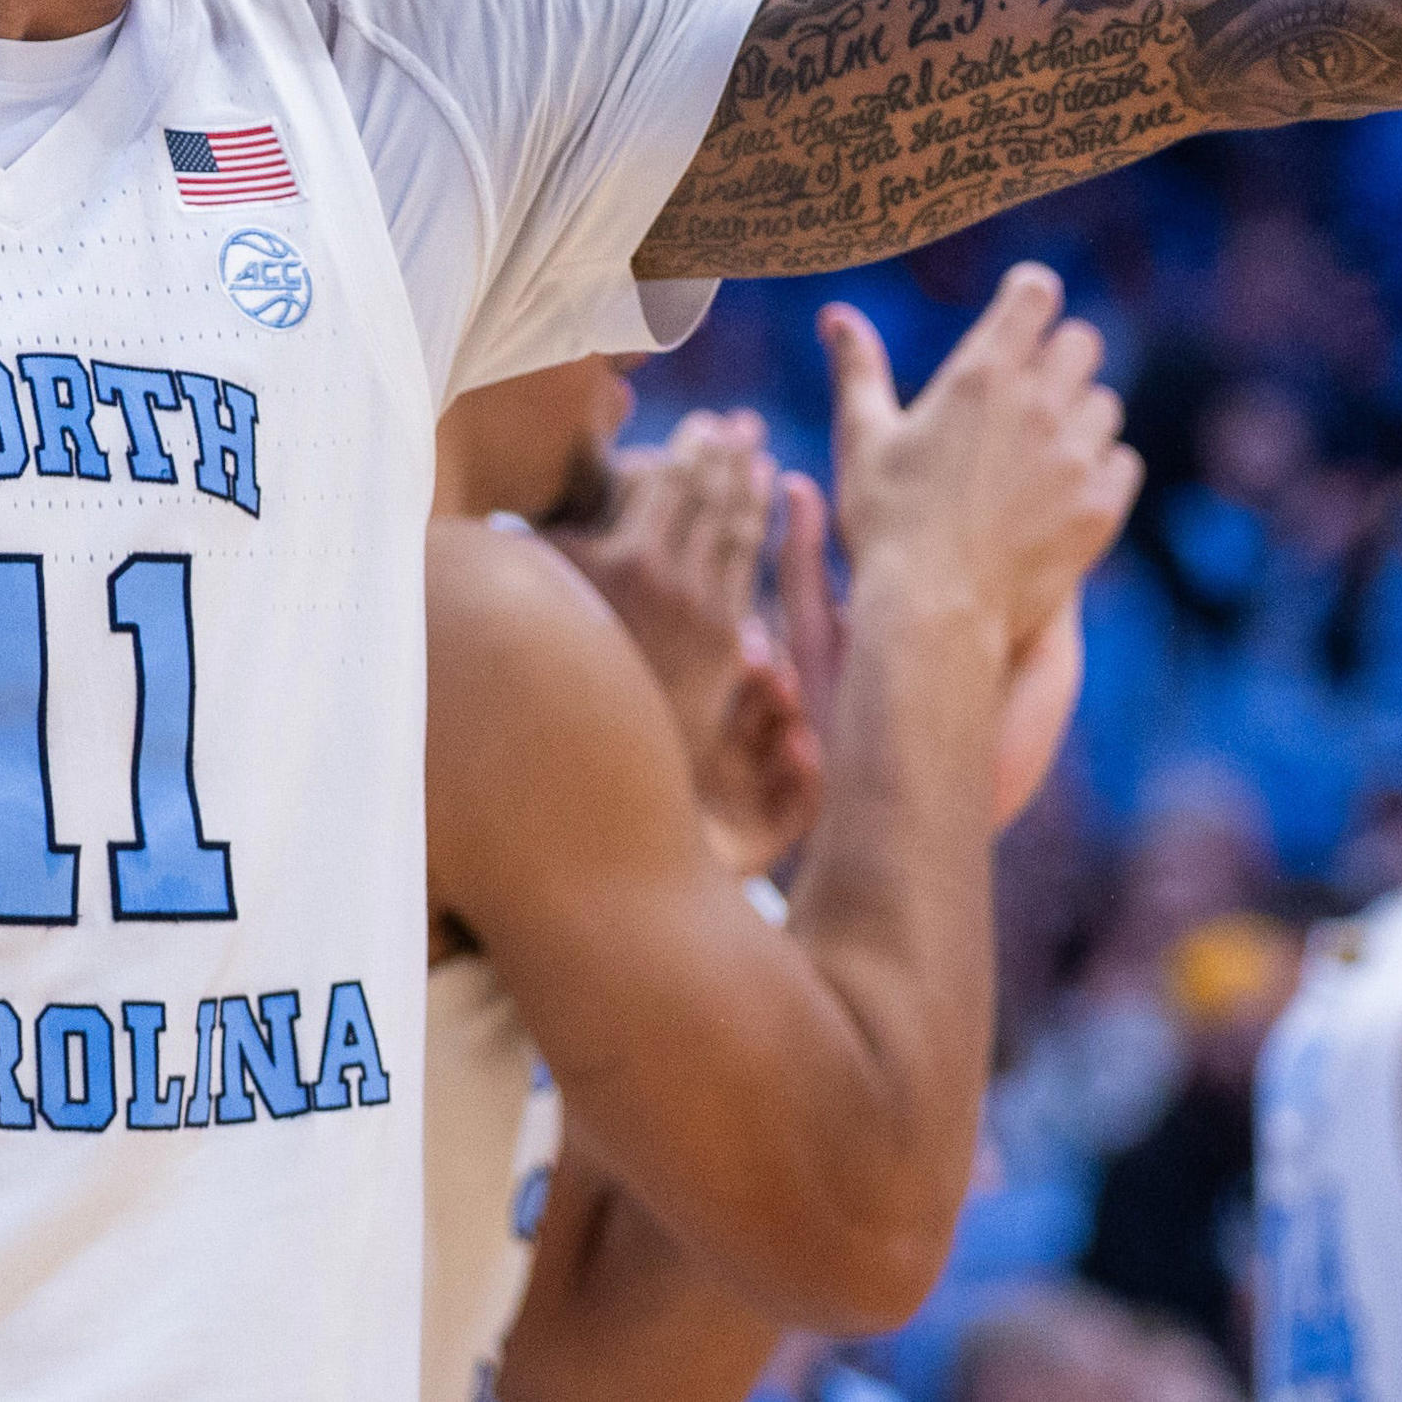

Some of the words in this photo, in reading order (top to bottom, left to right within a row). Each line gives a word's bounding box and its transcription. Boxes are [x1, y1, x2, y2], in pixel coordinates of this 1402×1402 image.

[937, 36, 1022, 101] walk
[751, 215, 793, 239] no
[797, 183, 866, 230] evil
[233, 260, 302, 286] ACC
